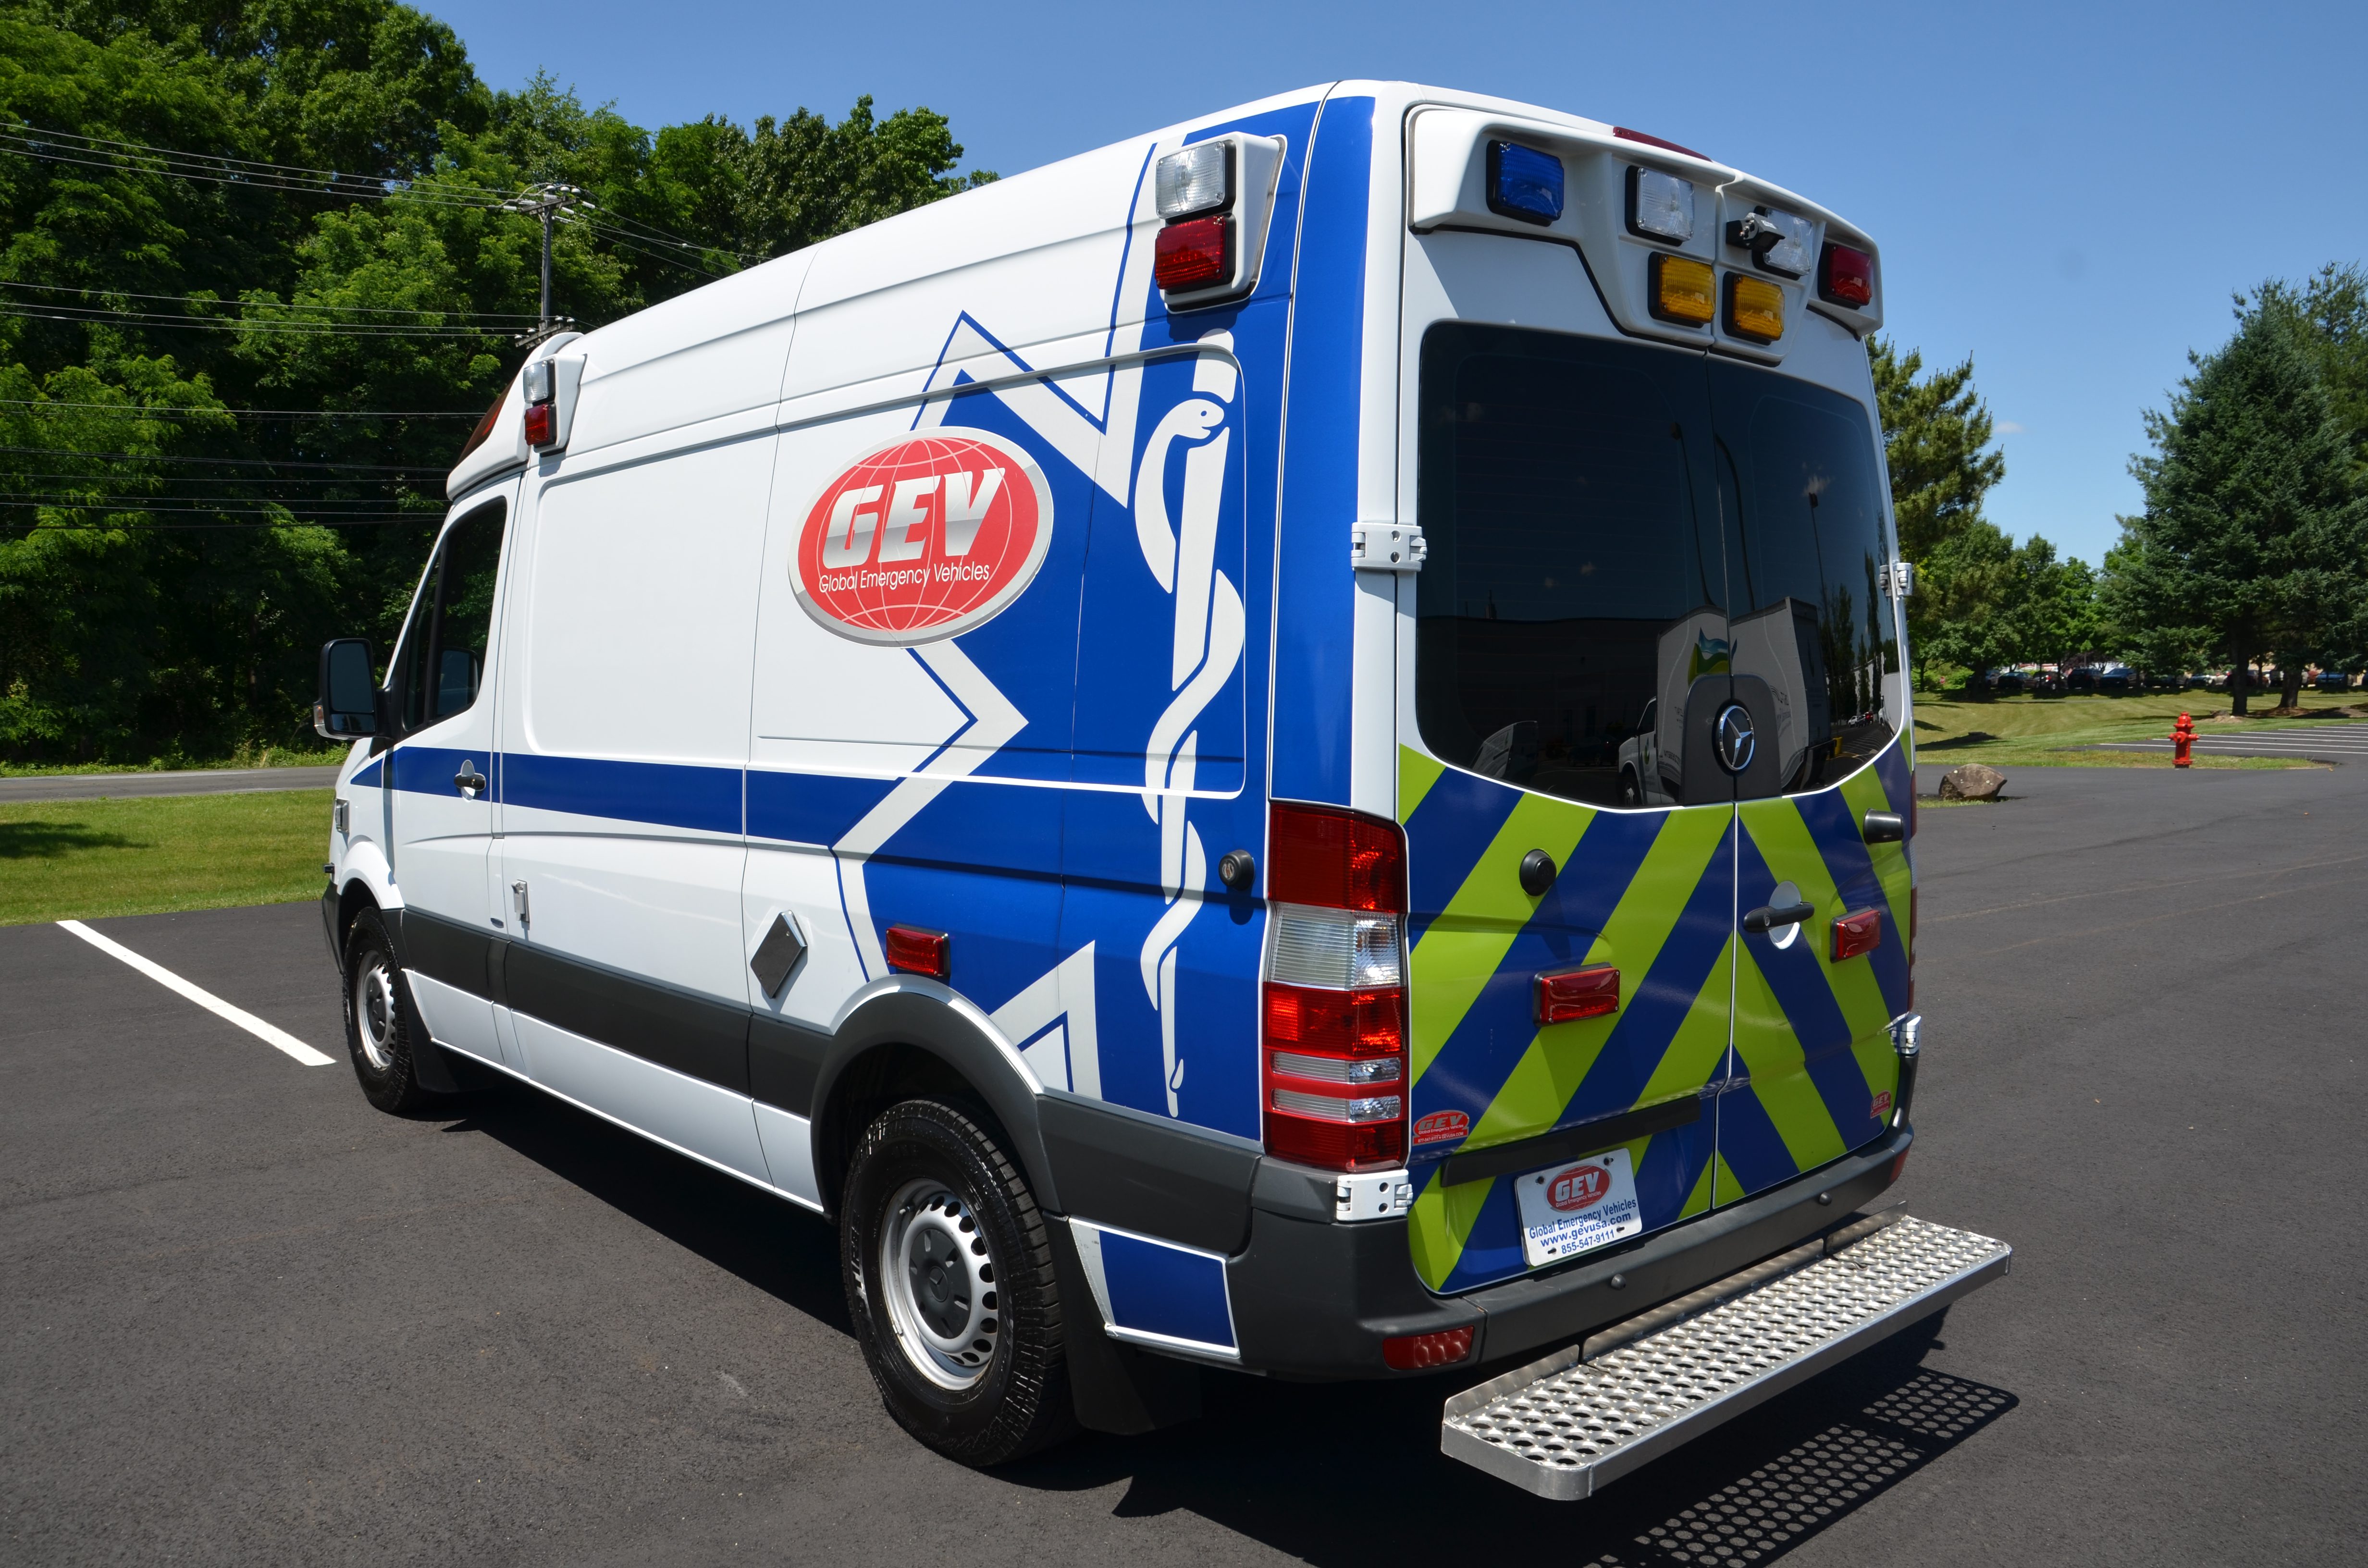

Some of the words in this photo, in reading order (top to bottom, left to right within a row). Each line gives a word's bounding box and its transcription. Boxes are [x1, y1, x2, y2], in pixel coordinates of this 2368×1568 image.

[822, 467, 1005, 569] GEV
[819, 571, 858, 593] Global
[860, 567, 930, 590] Emergency
[934, 561, 989, 582] Vehicles
[1873, 1093, 1889, 1107] GEV
[1418, 1115, 1463, 1130] GEV
[1555, 1171, 1599, 1201] GEV
[1568, 1196, 1587, 1204] Emergency
[1529, 1221, 1555, 1239] Global
[1558, 1210, 1601, 1231] Emergency
[1603, 1199, 1636, 1216] Vehicles
[1540, 1213, 1631, 1247] www.gevusa.com
[1561, 1229, 1615, 1254] 855-547-9111
